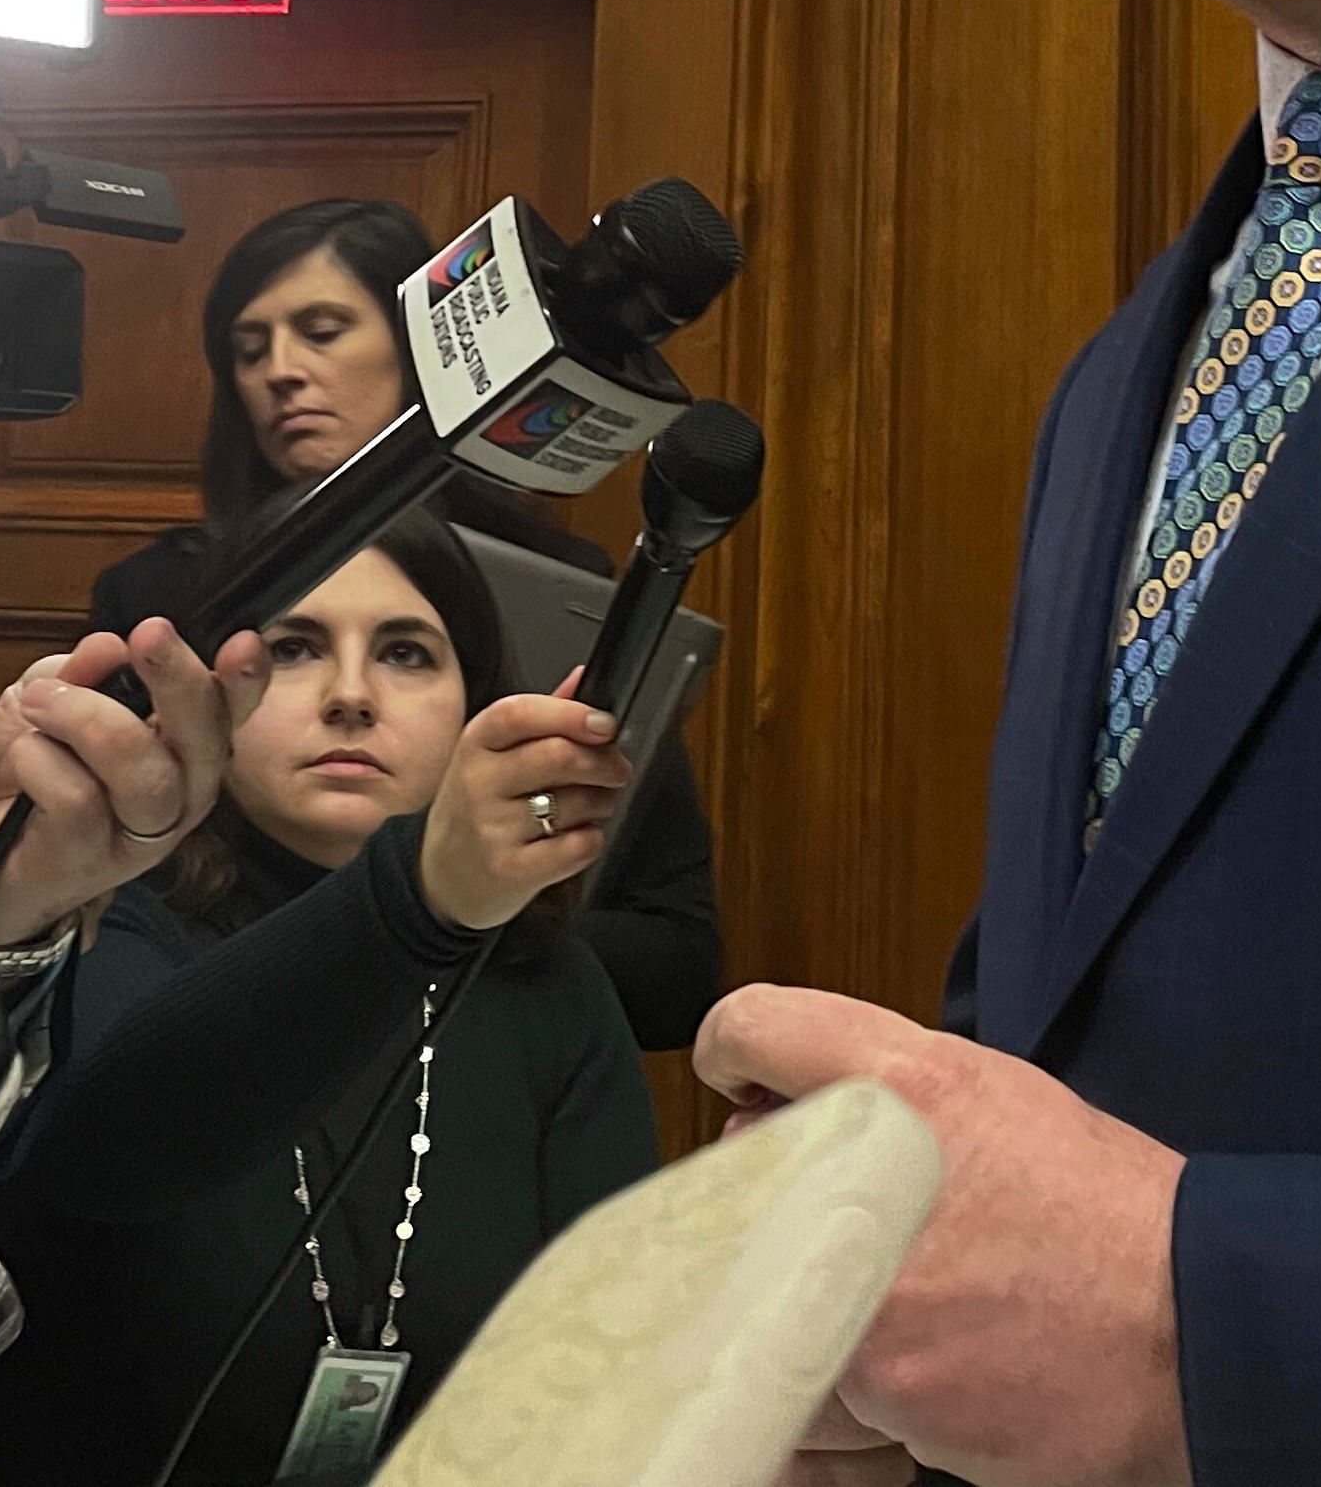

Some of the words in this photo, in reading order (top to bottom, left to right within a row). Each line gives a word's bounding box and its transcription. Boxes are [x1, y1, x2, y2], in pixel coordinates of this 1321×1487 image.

[466, 275, 490, 325] PUBLIC
[484, 260, 511, 319] INDIANA
[430, 305, 458, 369] STATIONS
[448, 290, 492, 395] BROADCASTING
